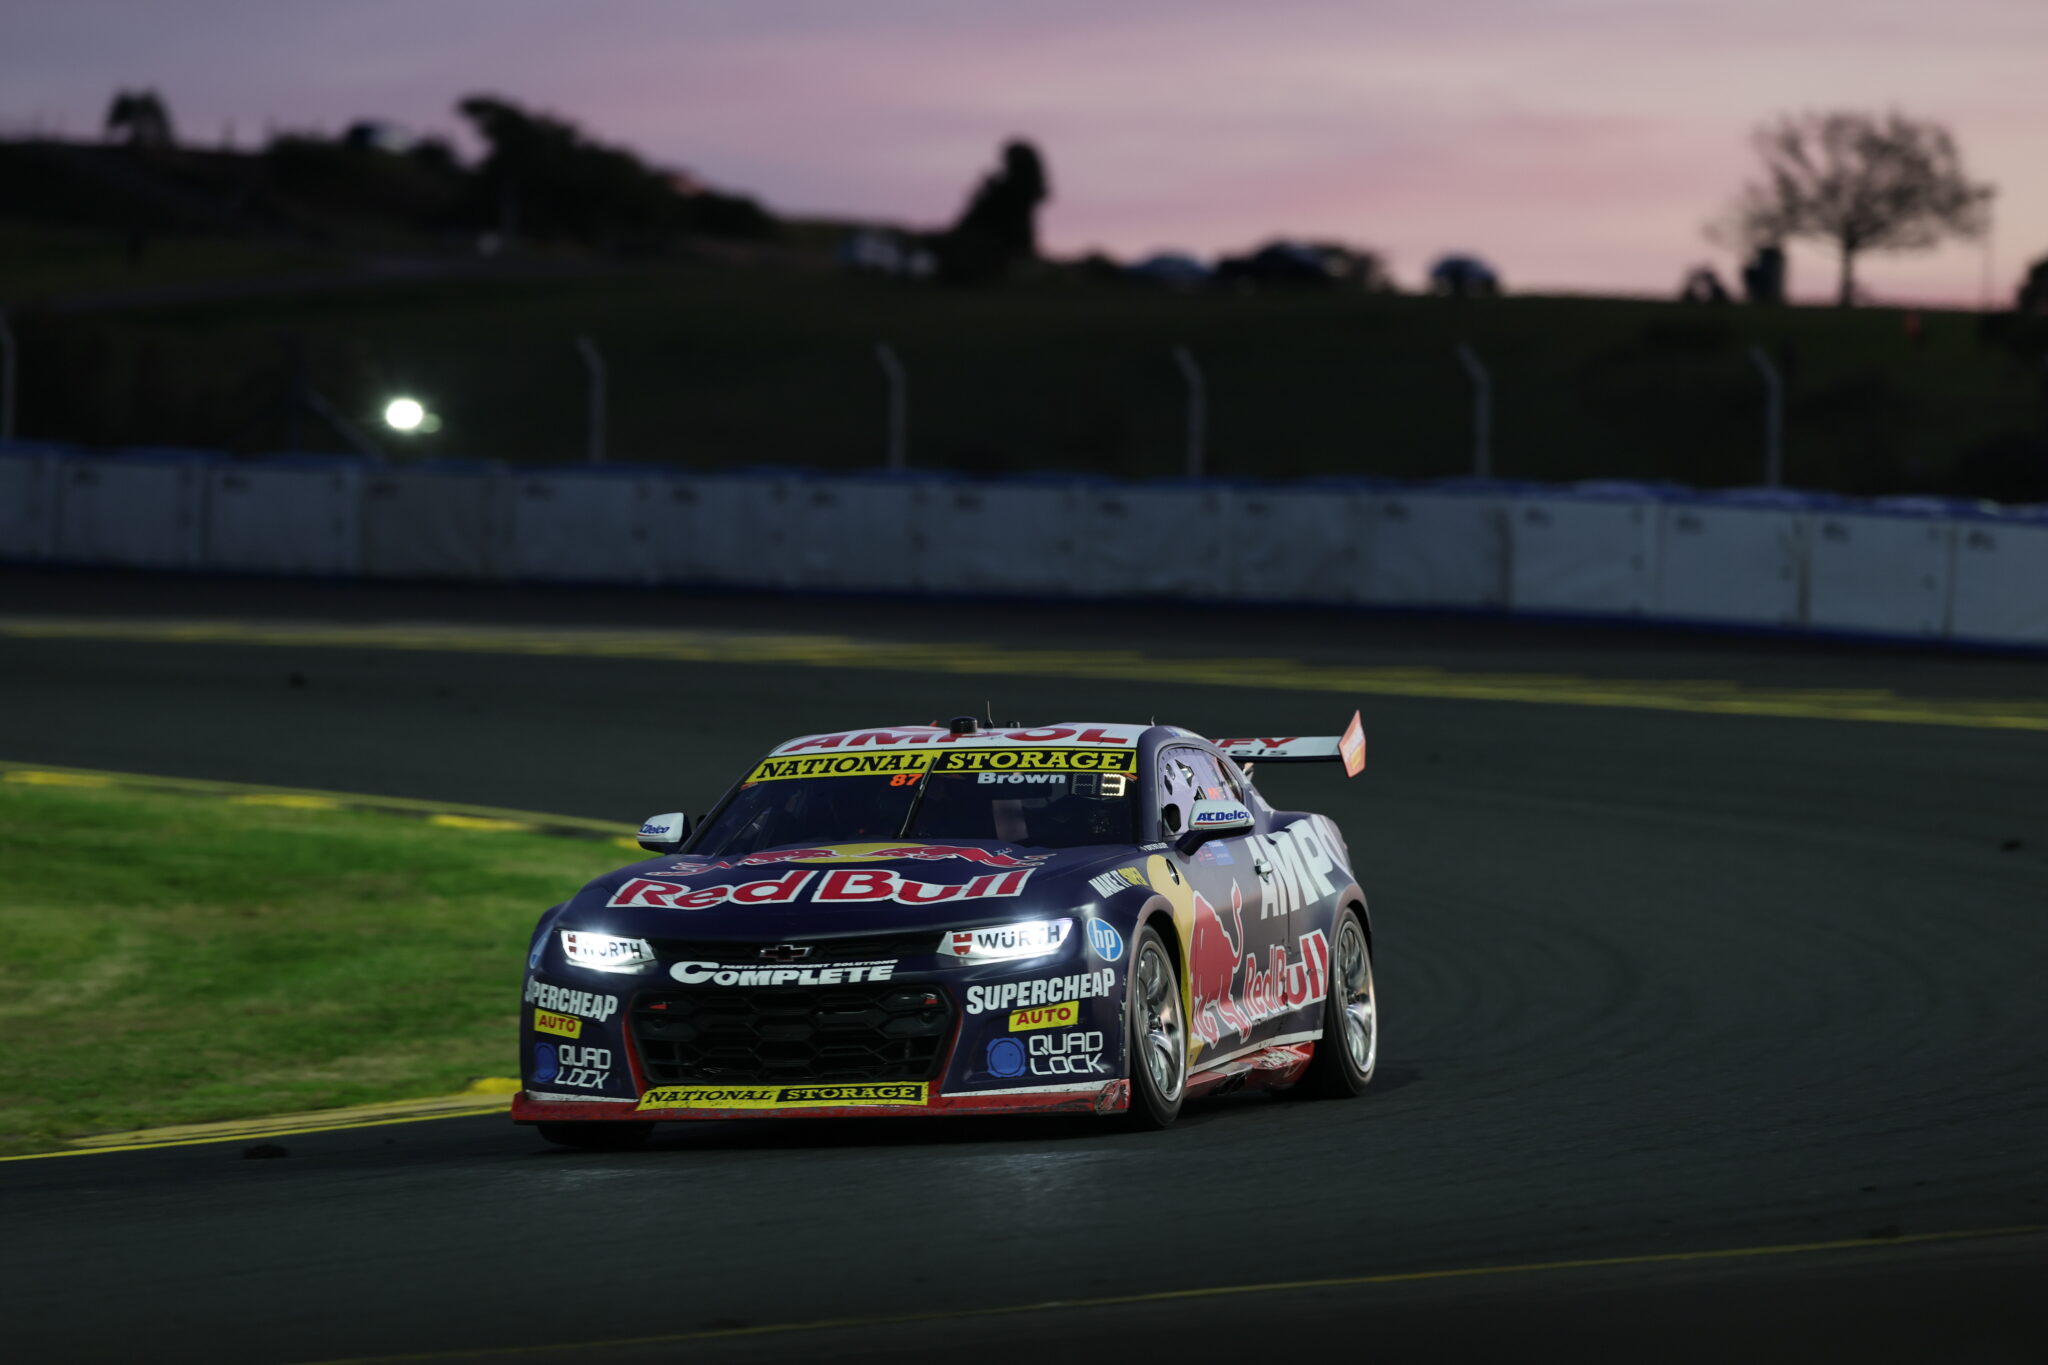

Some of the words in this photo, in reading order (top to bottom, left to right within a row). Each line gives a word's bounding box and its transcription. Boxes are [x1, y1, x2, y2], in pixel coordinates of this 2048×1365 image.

[783, 727, 1129, 752] AMPOL
[756, 754, 928, 778] NATIONAL
[946, 750, 1126, 770] STORAGE
[889, 774, 923, 787] 87
[977, 772, 1066, 784] Brown
[1196, 810, 1251, 821] ACDelco
[606, 870, 811, 910] Red
[812, 868, 1037, 905] Bull
[1091, 919, 1117, 959] hp
[670, 960, 896, 987] COMPLETE
[1243, 945, 1277, 1020] Red
[1272, 929, 1330, 1014] Bull
[966, 967, 1116, 1015] SUPERCHEAP
[538, 1014, 577, 1033] AUTO
[1016, 1008, 1071, 1026] AUTO
[1029, 1030, 1104, 1056] QUAD
[558, 1044, 612, 1070] QUAD
[1029, 1052, 1106, 1076] LOCK
[554, 1066, 610, 1089] LOCK
[646, 1090, 773, 1103] NATIONAL
[786, 1086, 916, 1100] STORAGE
